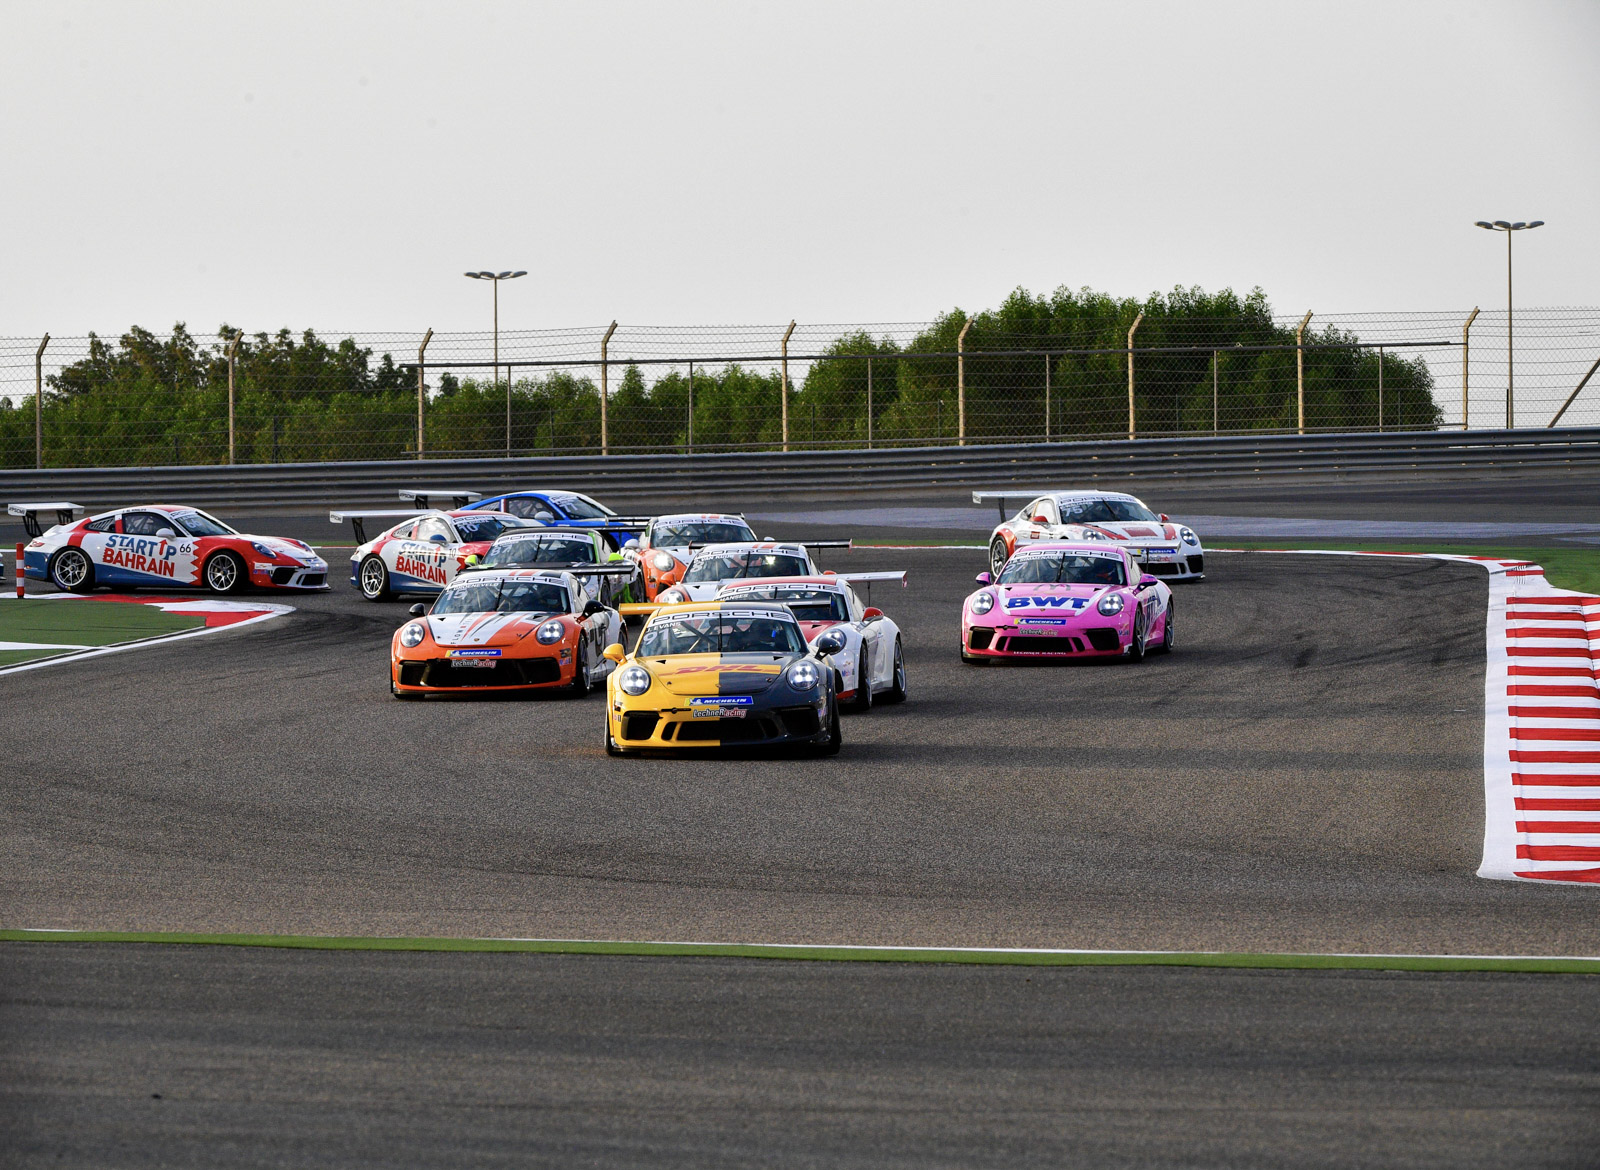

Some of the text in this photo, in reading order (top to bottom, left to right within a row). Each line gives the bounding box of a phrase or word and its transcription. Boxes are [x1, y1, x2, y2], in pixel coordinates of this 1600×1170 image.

[559, 502, 579, 513] 77
[1061, 505, 1083, 517] 75
[459, 523, 480, 534] 10
[497, 533, 588, 543] PORSCHE
[179, 543, 192, 553] 66
[490, 544, 513, 556] 87
[697, 548, 801, 558] PORSCHE
[1014, 550, 1120, 560] PORSCHE
[102, 547, 176, 578] BAHRAIN
[1003, 561, 1029, 575] 27
[395, 555, 447, 585] BAHRAIN
[450, 576, 566, 588] PORSCHE
[446, 589, 469, 601] 15
[720, 584, 840, 597] PORSCHE
[1007, 596, 1090, 609] BWT
[652, 611, 791, 624] PORSCHE
[642, 628, 671, 646] 91
[674, 665, 763, 675] DHL
